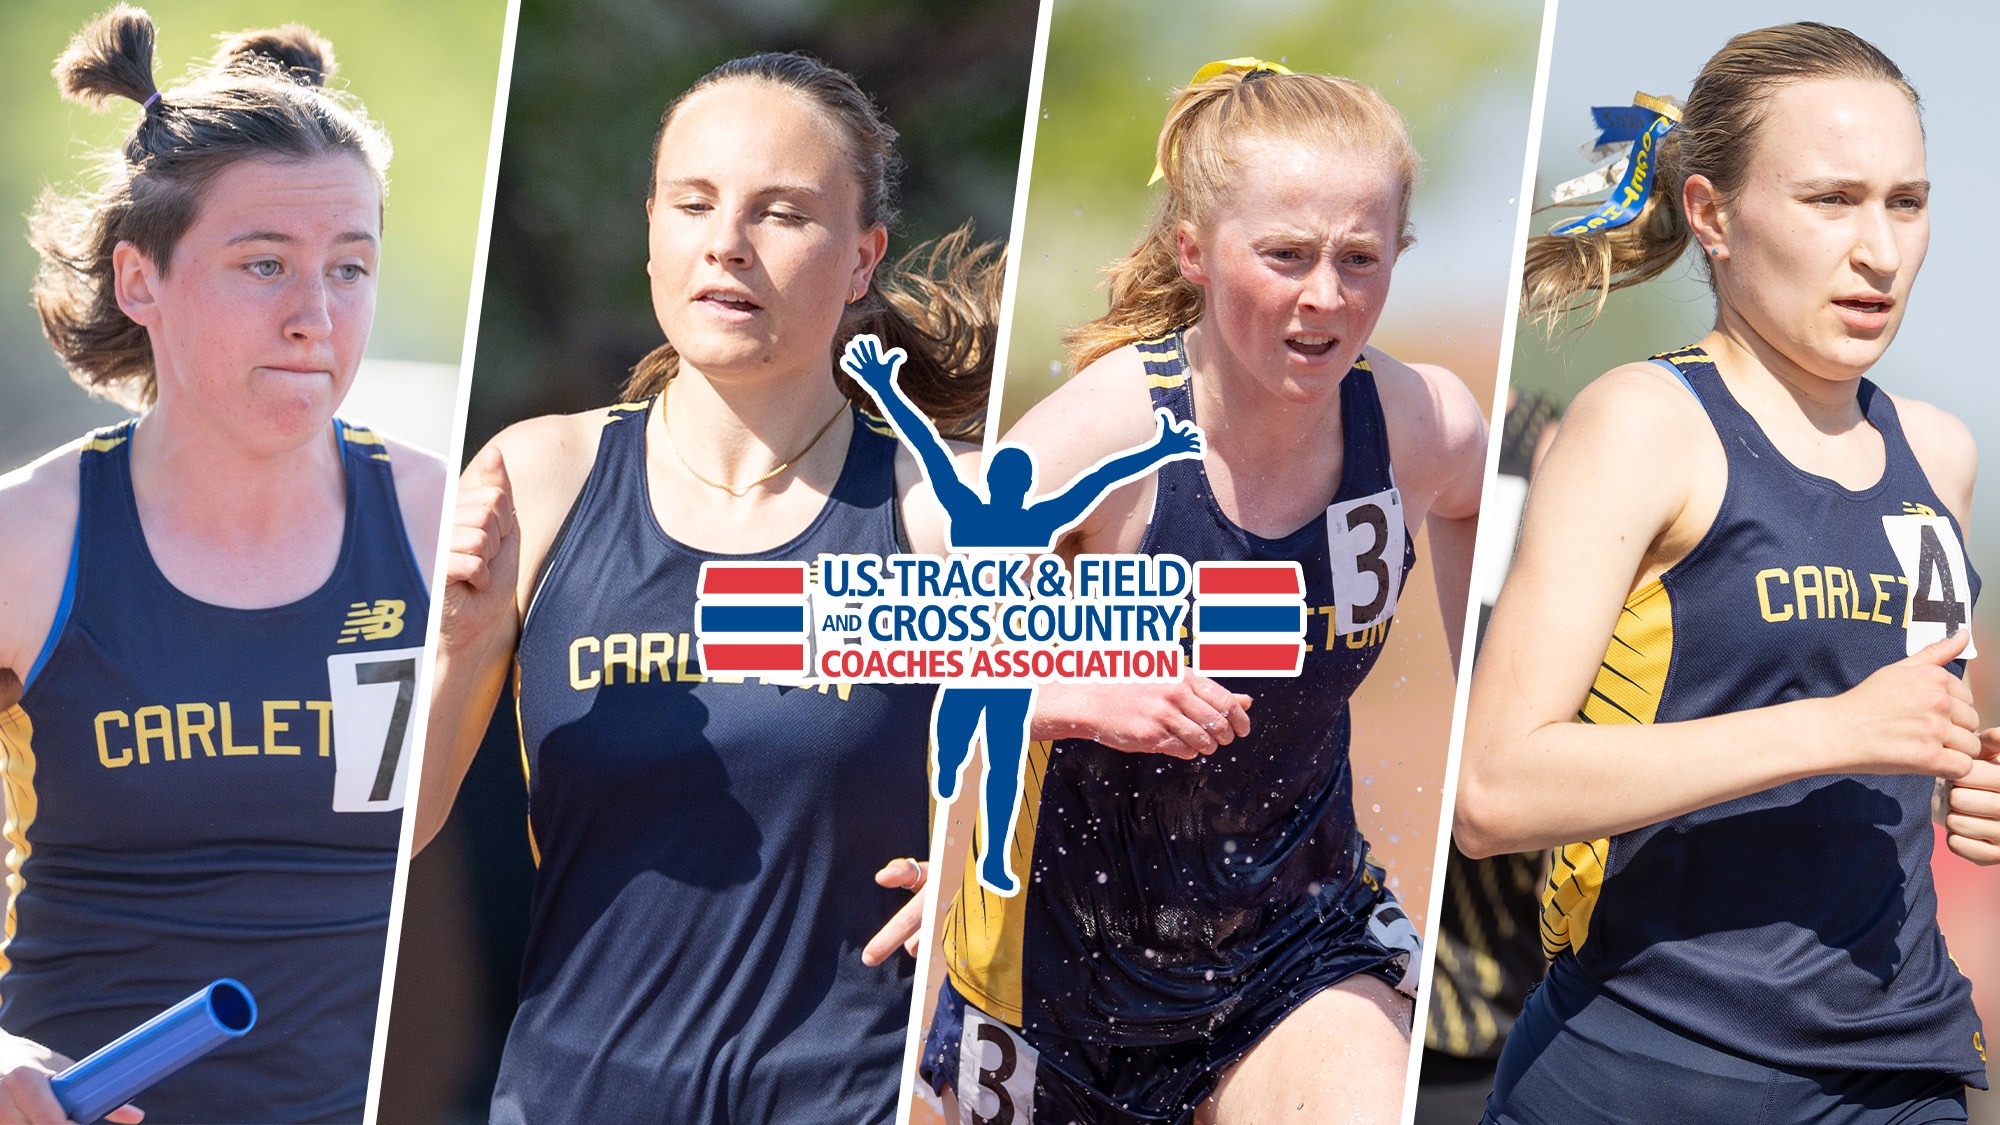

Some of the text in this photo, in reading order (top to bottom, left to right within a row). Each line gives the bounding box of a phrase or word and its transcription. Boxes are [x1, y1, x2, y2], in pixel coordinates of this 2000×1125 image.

[1346, 504, 1390, 625] 3
[1911, 525, 1966, 640] 4
[355, 658, 415, 802] 7
[971, 1023, 1018, 1125] 3
